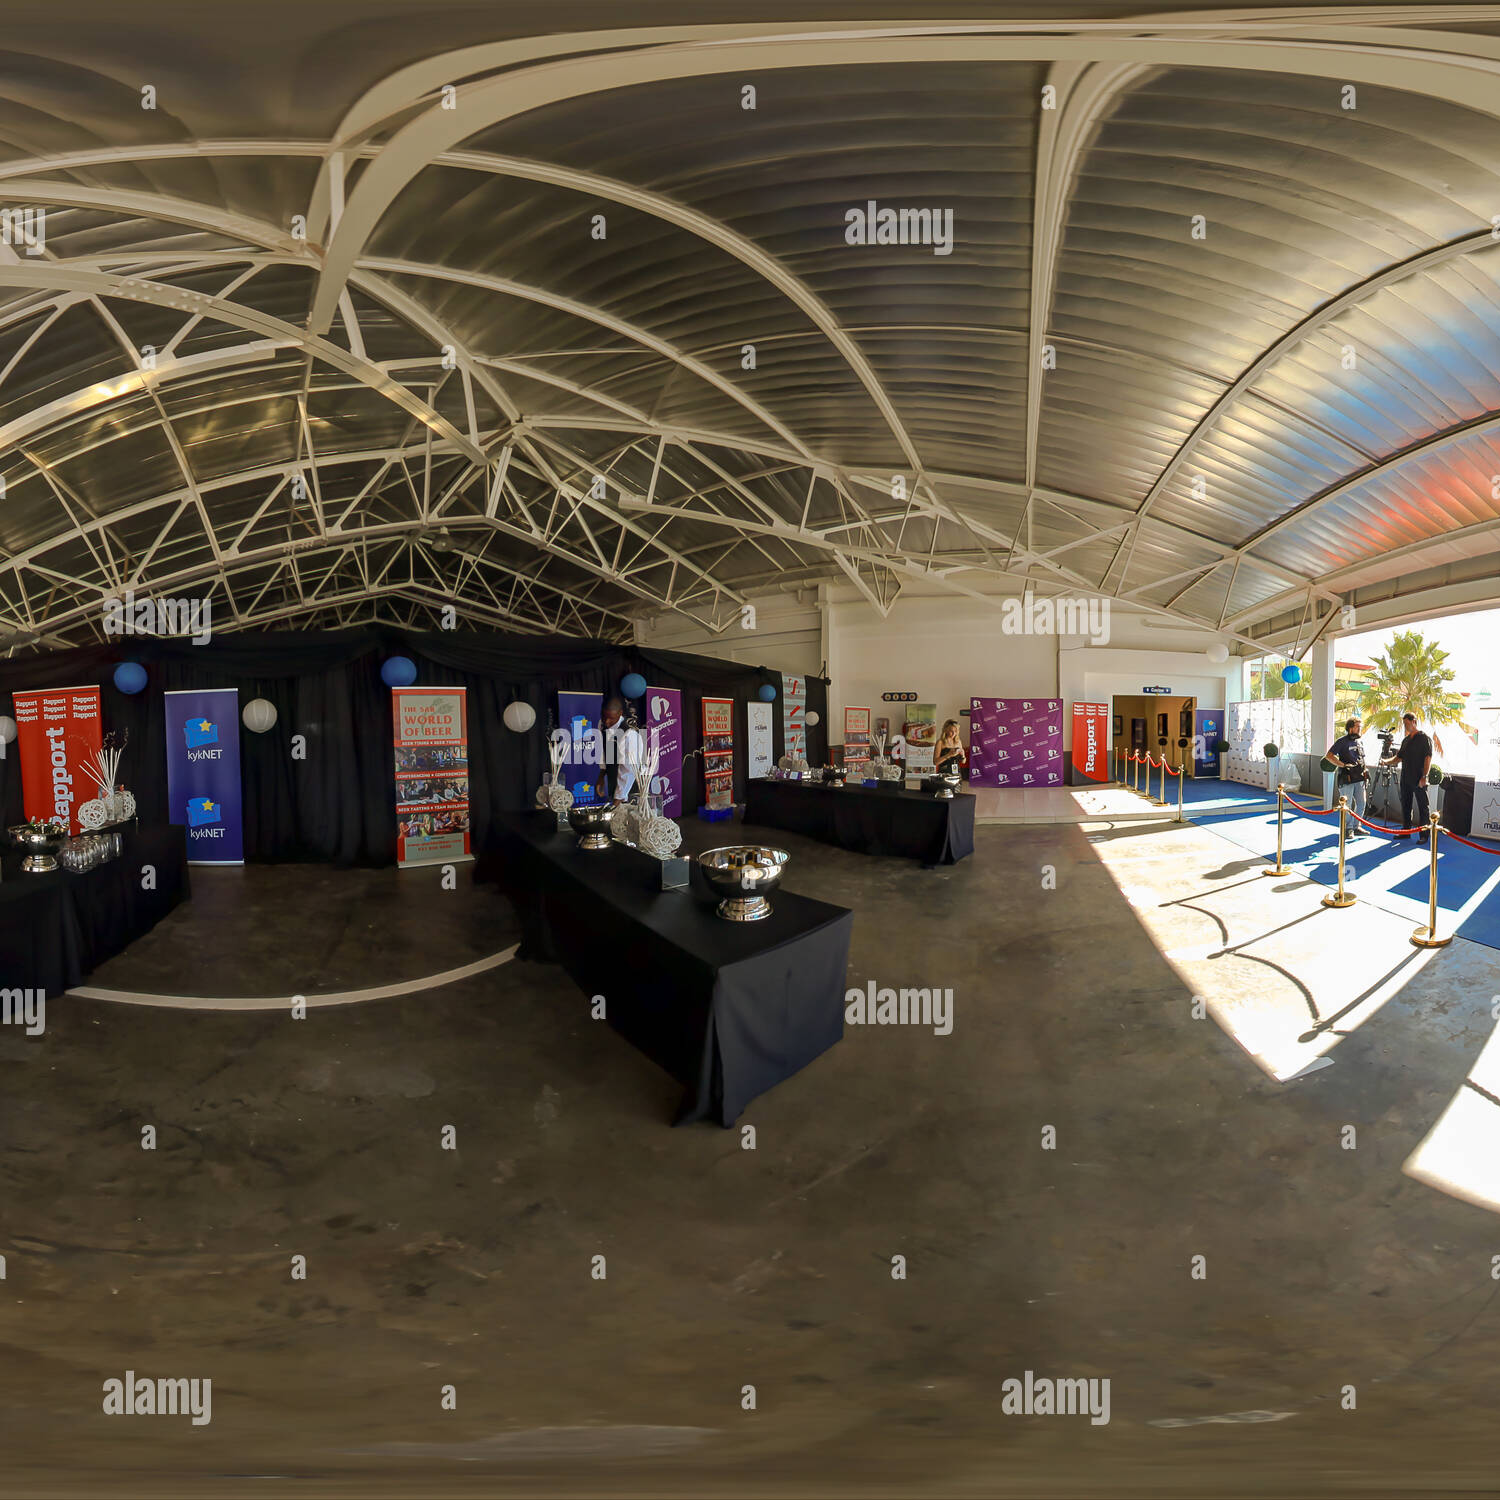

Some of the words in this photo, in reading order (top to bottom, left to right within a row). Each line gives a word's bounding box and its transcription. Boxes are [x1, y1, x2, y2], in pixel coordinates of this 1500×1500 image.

[404, 715, 452, 725] WORLD
[404, 728, 419, 737] OF
[424, 727, 452, 736] BEER
[1085, 718, 1097, 772] Rapport
[187, 749, 223, 762] kykNET
[190, 828, 225, 840] kykNET
